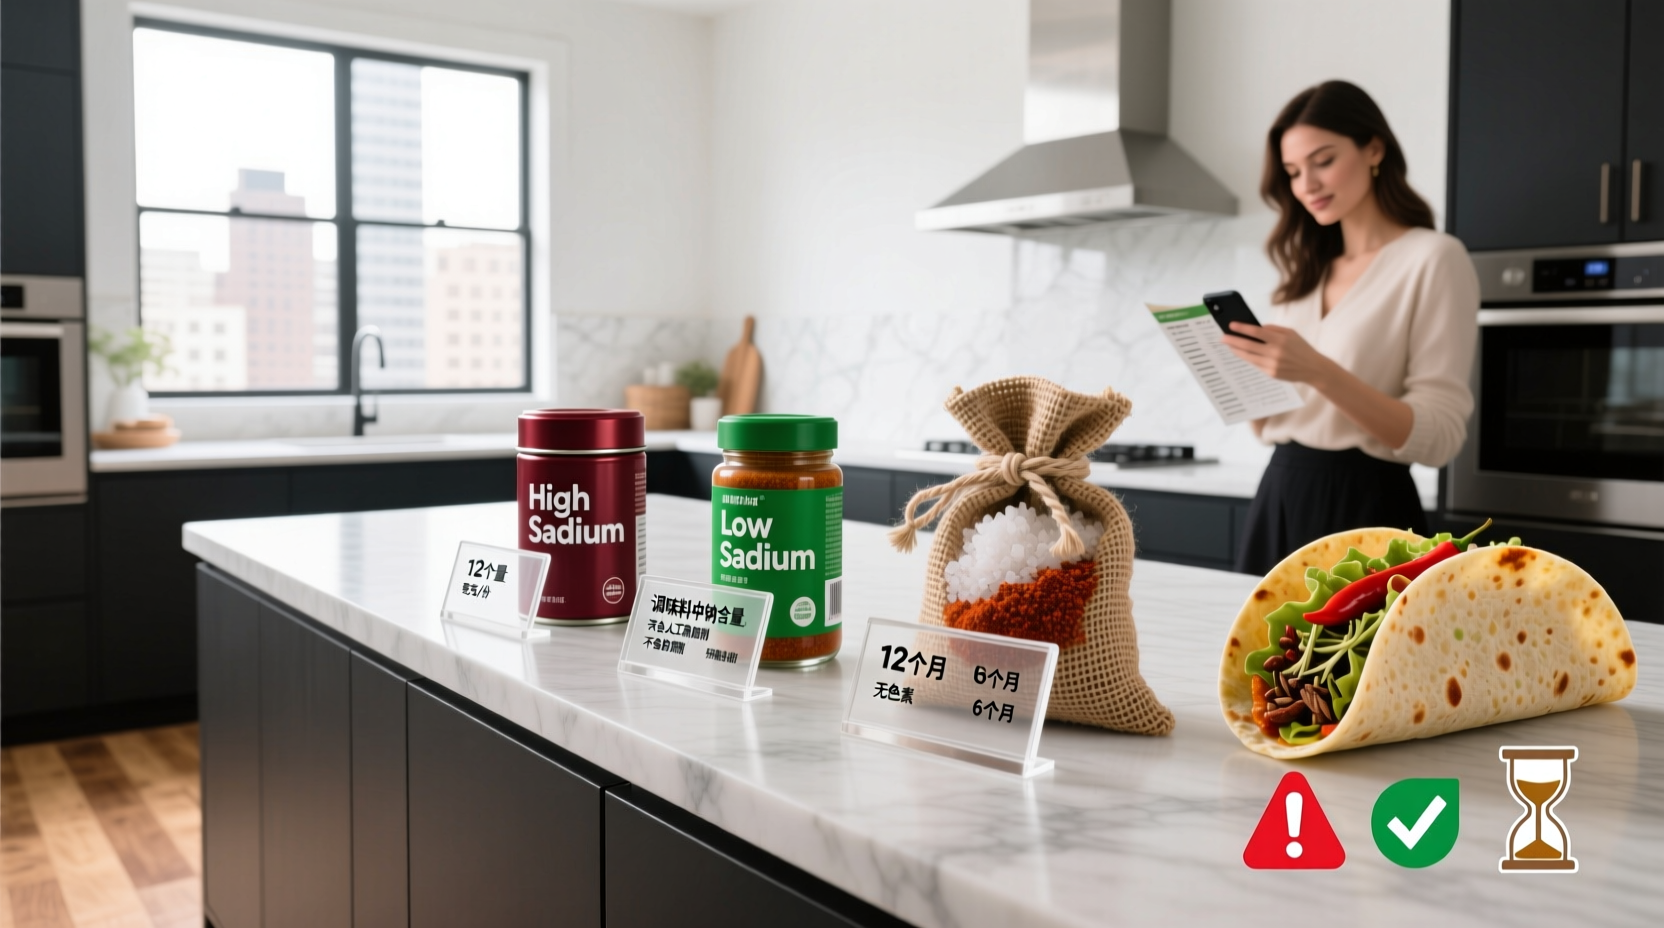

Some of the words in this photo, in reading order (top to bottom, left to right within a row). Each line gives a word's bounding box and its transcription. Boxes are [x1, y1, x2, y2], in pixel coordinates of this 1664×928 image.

[528, 483, 590, 519] High
[528, 515, 625, 545] Sadium
[720, 509, 773, 538] Low
[719, 541, 816, 571] Sadium
[881, 645, 947, 680] 12个月
[974, 665, 1020, 692] 6个月
[973, 699, 1015, 723] 6个月
